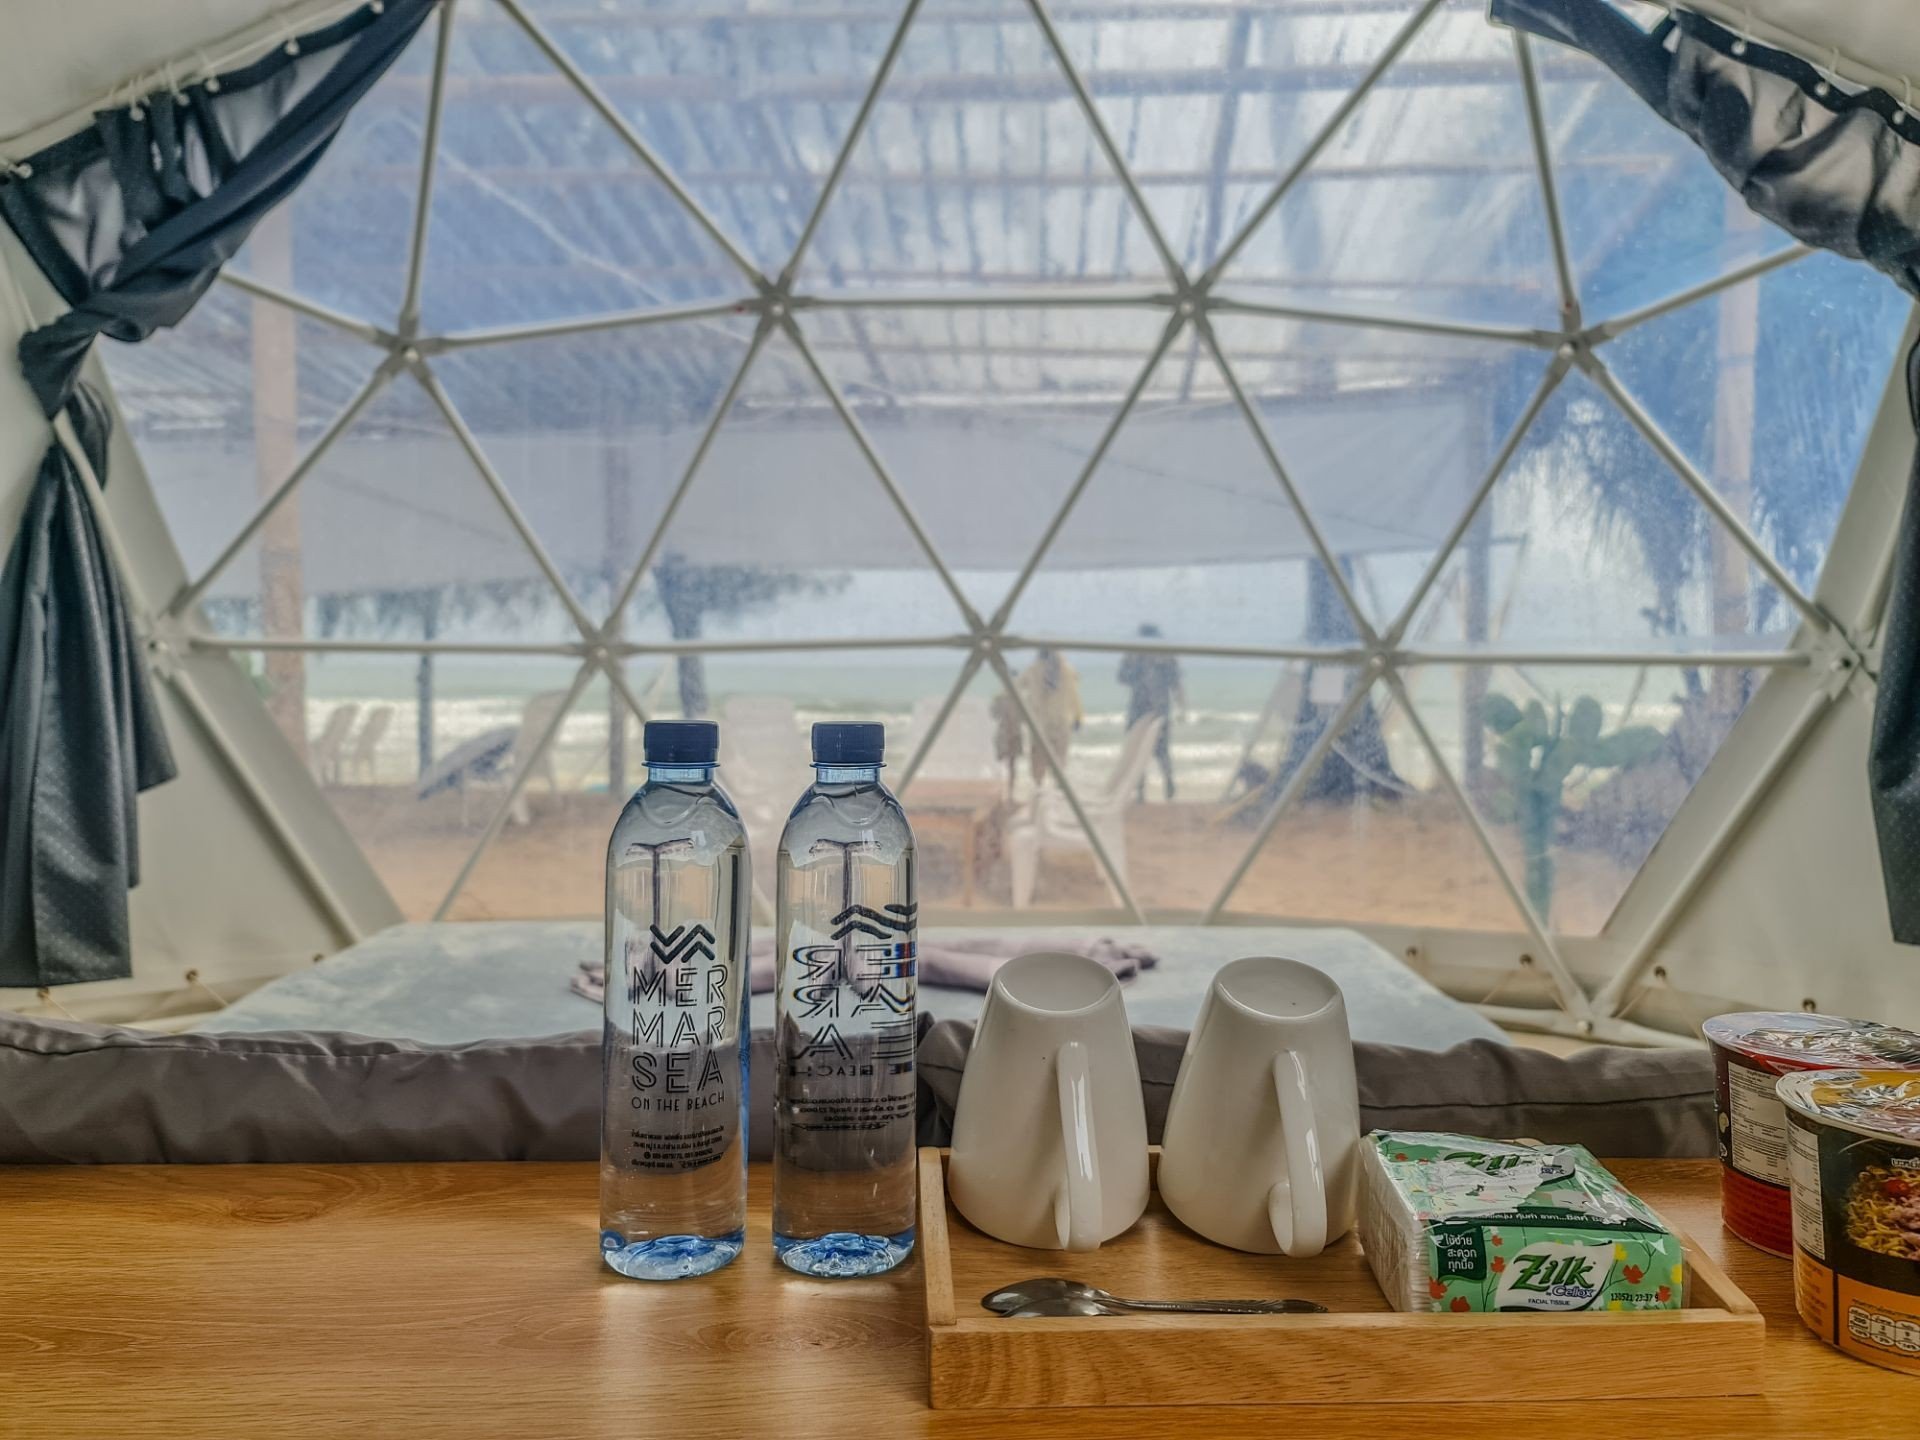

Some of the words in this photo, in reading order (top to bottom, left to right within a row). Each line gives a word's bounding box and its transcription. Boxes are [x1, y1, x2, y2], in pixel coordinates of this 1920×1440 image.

[633, 964, 728, 1007] MER
[632, 1006, 726, 1048] MAR
[632, 1049, 724, 1093] SEA
[631, 1096, 650, 1110] ON
[656, 1098, 680, 1112] THE
[687, 1090, 725, 1111] BEACH
[1508, 1254, 1595, 1293] Zilk
[1552, 1284, 1595, 1299] Cellox
